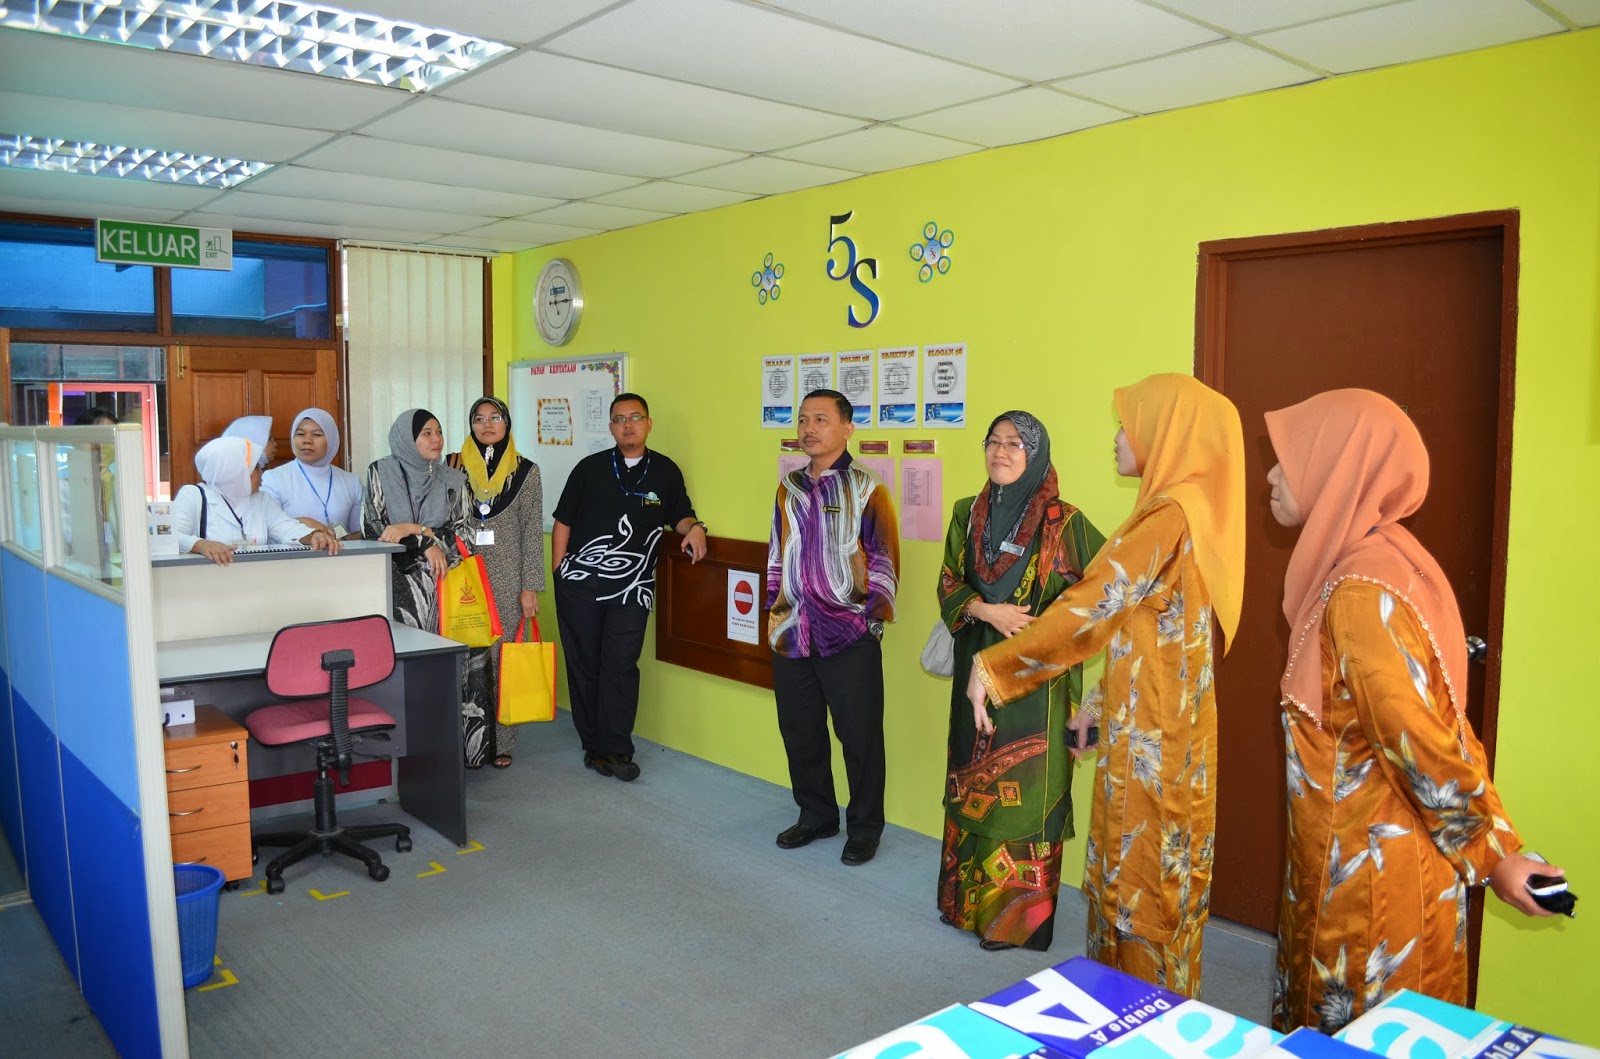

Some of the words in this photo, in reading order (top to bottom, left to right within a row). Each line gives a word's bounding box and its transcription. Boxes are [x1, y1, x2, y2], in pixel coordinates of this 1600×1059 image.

[102, 228, 196, 259] KELUAR
[205, 251, 217, 259] EXIT
[928, 349, 954, 357] SLOGAN
[531, 366, 545, 375] PAPAN
[1108, 998, 1172, 1032] Double
